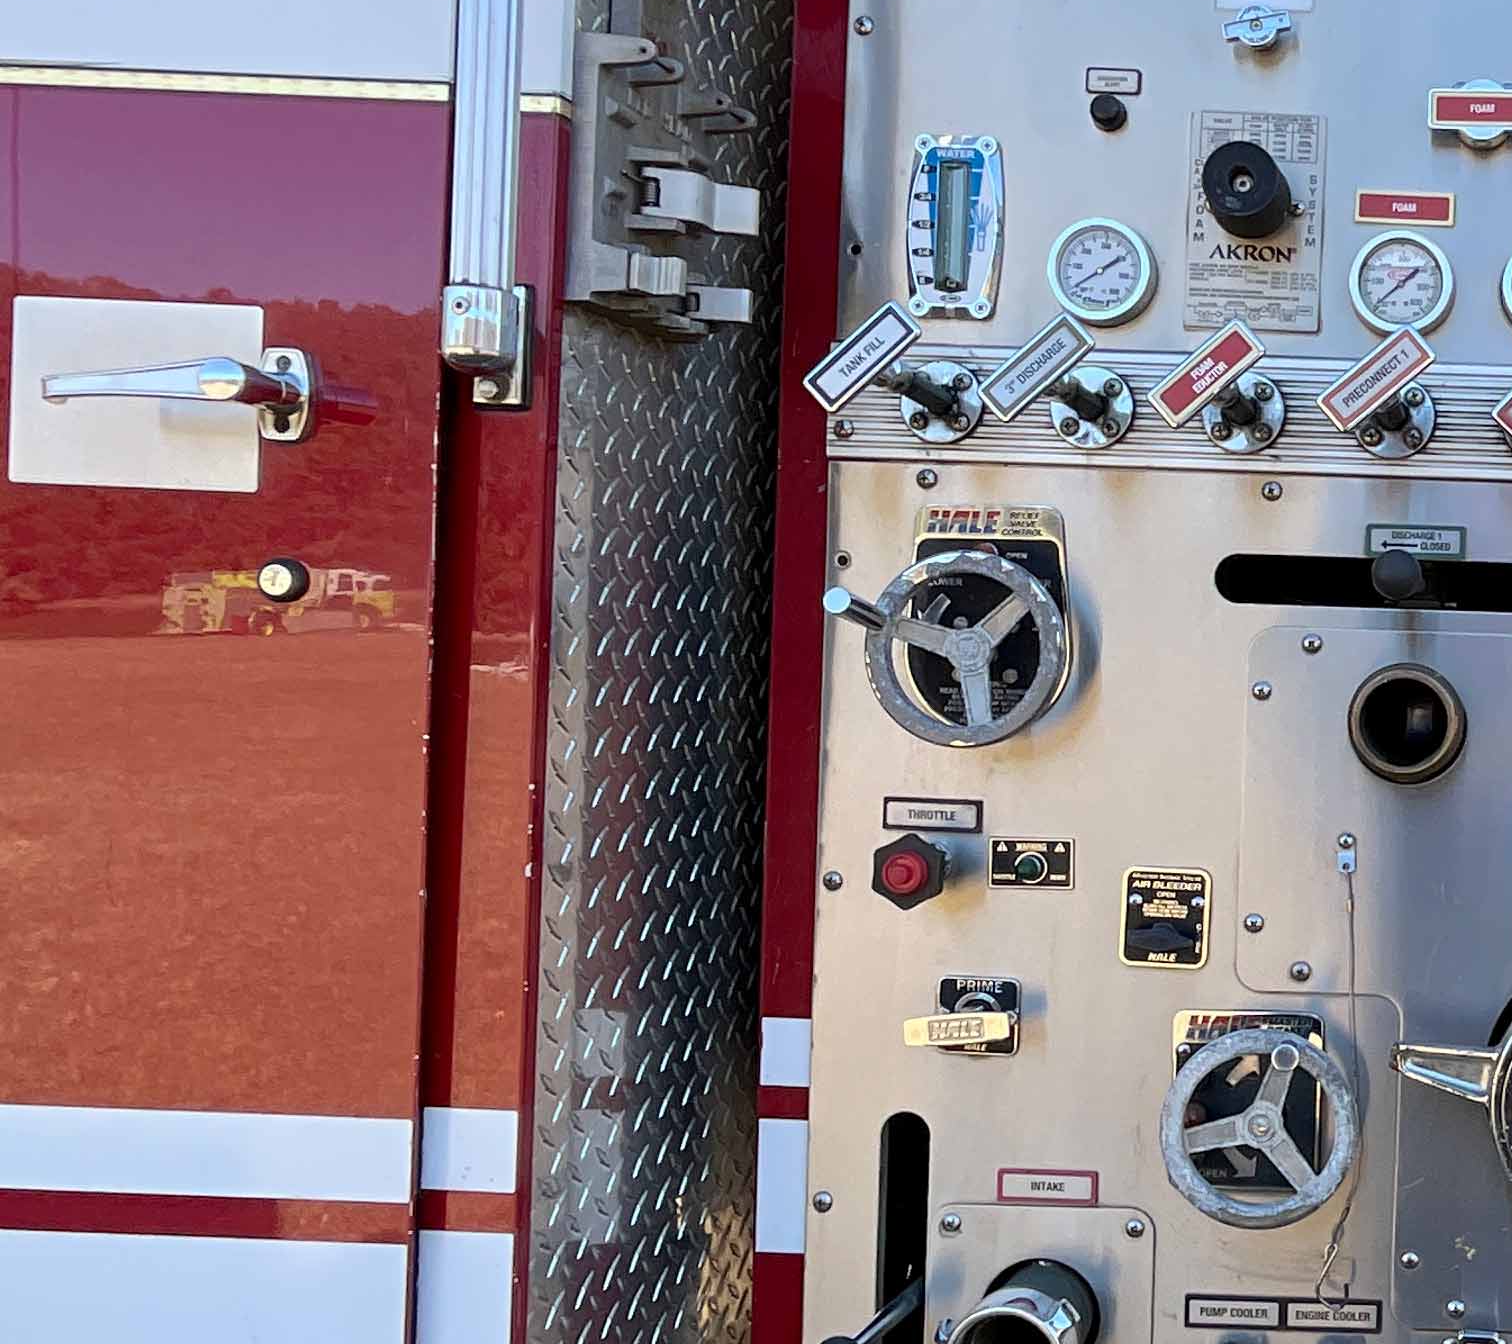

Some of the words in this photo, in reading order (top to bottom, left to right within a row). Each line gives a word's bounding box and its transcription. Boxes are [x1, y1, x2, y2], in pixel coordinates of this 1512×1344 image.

[1469, 102, 1495, 114] FOAM
[936, 148, 976, 159] WATER
[1392, 202, 1417, 213] FOAM
[1209, 244, 1293, 263] AKRON
[838, 350, 868, 379] TANK
[863, 336, 886, 359] FILL
[1015, 337, 1067, 385] DISCHARGE
[1190, 356, 1215, 380] FOAM
[1192, 361, 1229, 394] EDUCTOR
[1342, 359, 1402, 408] PRECONNECT
[927, 510, 1001, 534] HALE
[1001, 528, 1043, 536] CONTROL
[1420, 542, 1451, 551] CLOSED
[907, 809, 957, 821] THROTTLE
[1132, 880, 1151, 889] AIR
[1152, 881, 1202, 891] BLEEDER
[956, 979, 1003, 993] PRIME
[930, 1019, 982, 1040] HALE
[1030, 1180, 1065, 1194] INTAKE
[1200, 1306, 1228, 1318] PUMP
[1230, 1308, 1268, 1319] COOLER
[1295, 1310, 1330, 1321] ENGINE
[1332, 1311, 1371, 1321] COOLER
